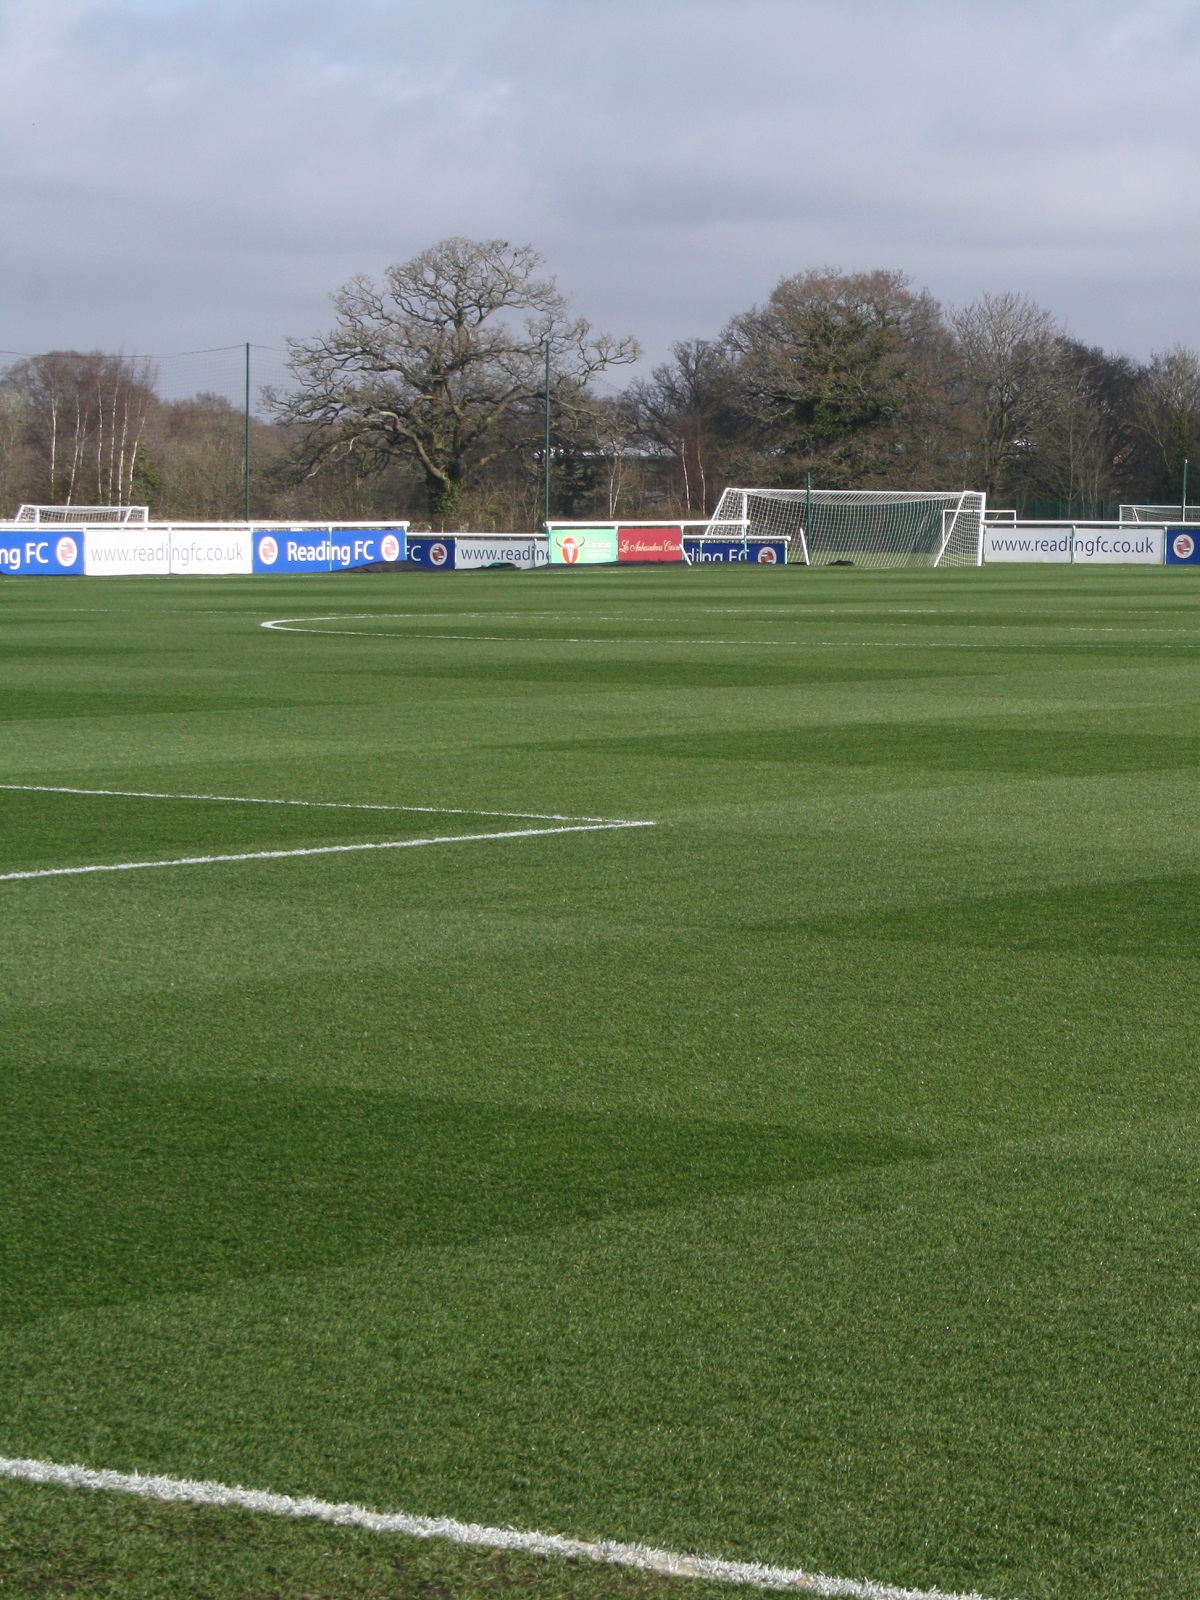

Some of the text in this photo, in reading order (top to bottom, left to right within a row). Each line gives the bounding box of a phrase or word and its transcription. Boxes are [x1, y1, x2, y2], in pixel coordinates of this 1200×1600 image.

[26, 542, 49, 563] FC
[91, 542, 243, 566] www.readingfc.co.uk
[287, 540, 374, 566] Reading FC
[407, 545, 422, 561] C
[991, 536, 1154, 556] www.readingfc.co.uk
